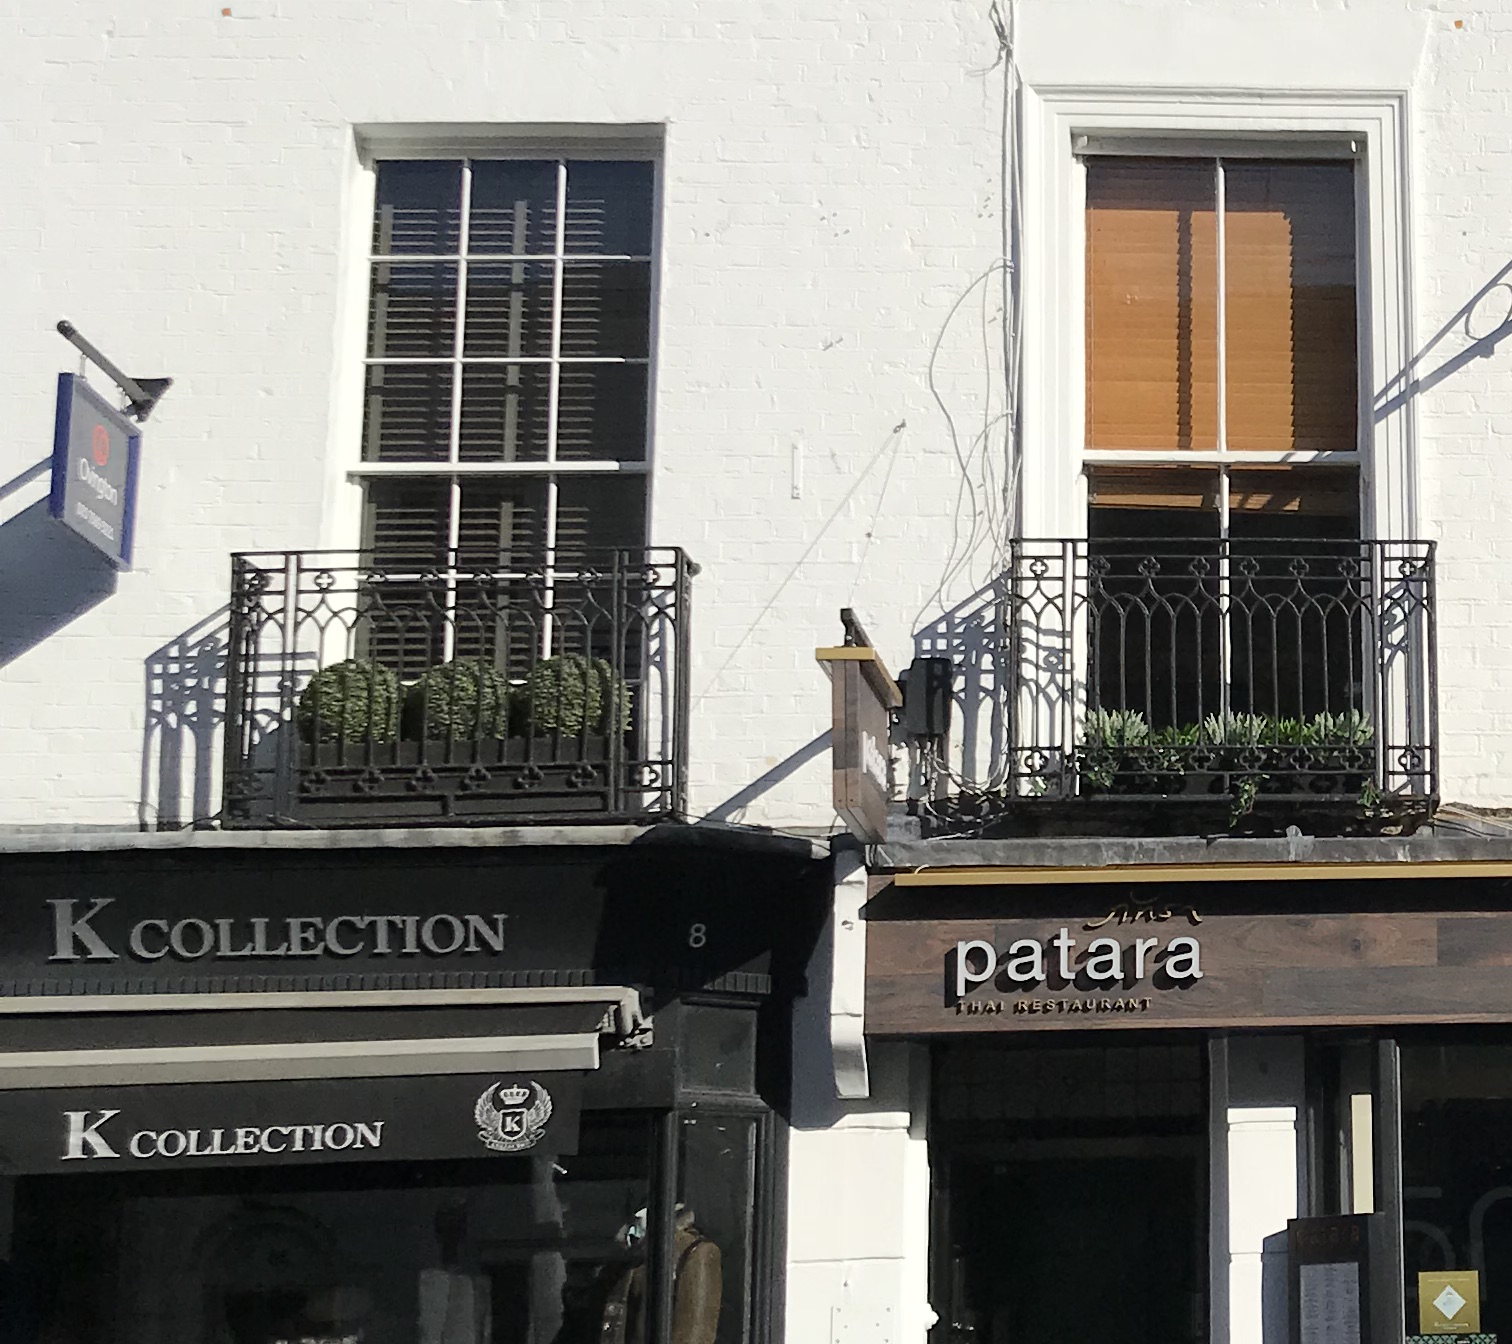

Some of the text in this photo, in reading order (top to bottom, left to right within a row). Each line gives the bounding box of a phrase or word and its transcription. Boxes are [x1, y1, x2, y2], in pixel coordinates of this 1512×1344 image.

[45, 897, 508, 961] K COLLECTION
[690, 923, 706, 948] 8
[956, 927, 1205, 997] patara
[959, 996, 1153, 1011] THAI RESTAURANT
[61, 1109, 385, 1160] K COLLECTION
[504, 1116, 521, 1133] K
